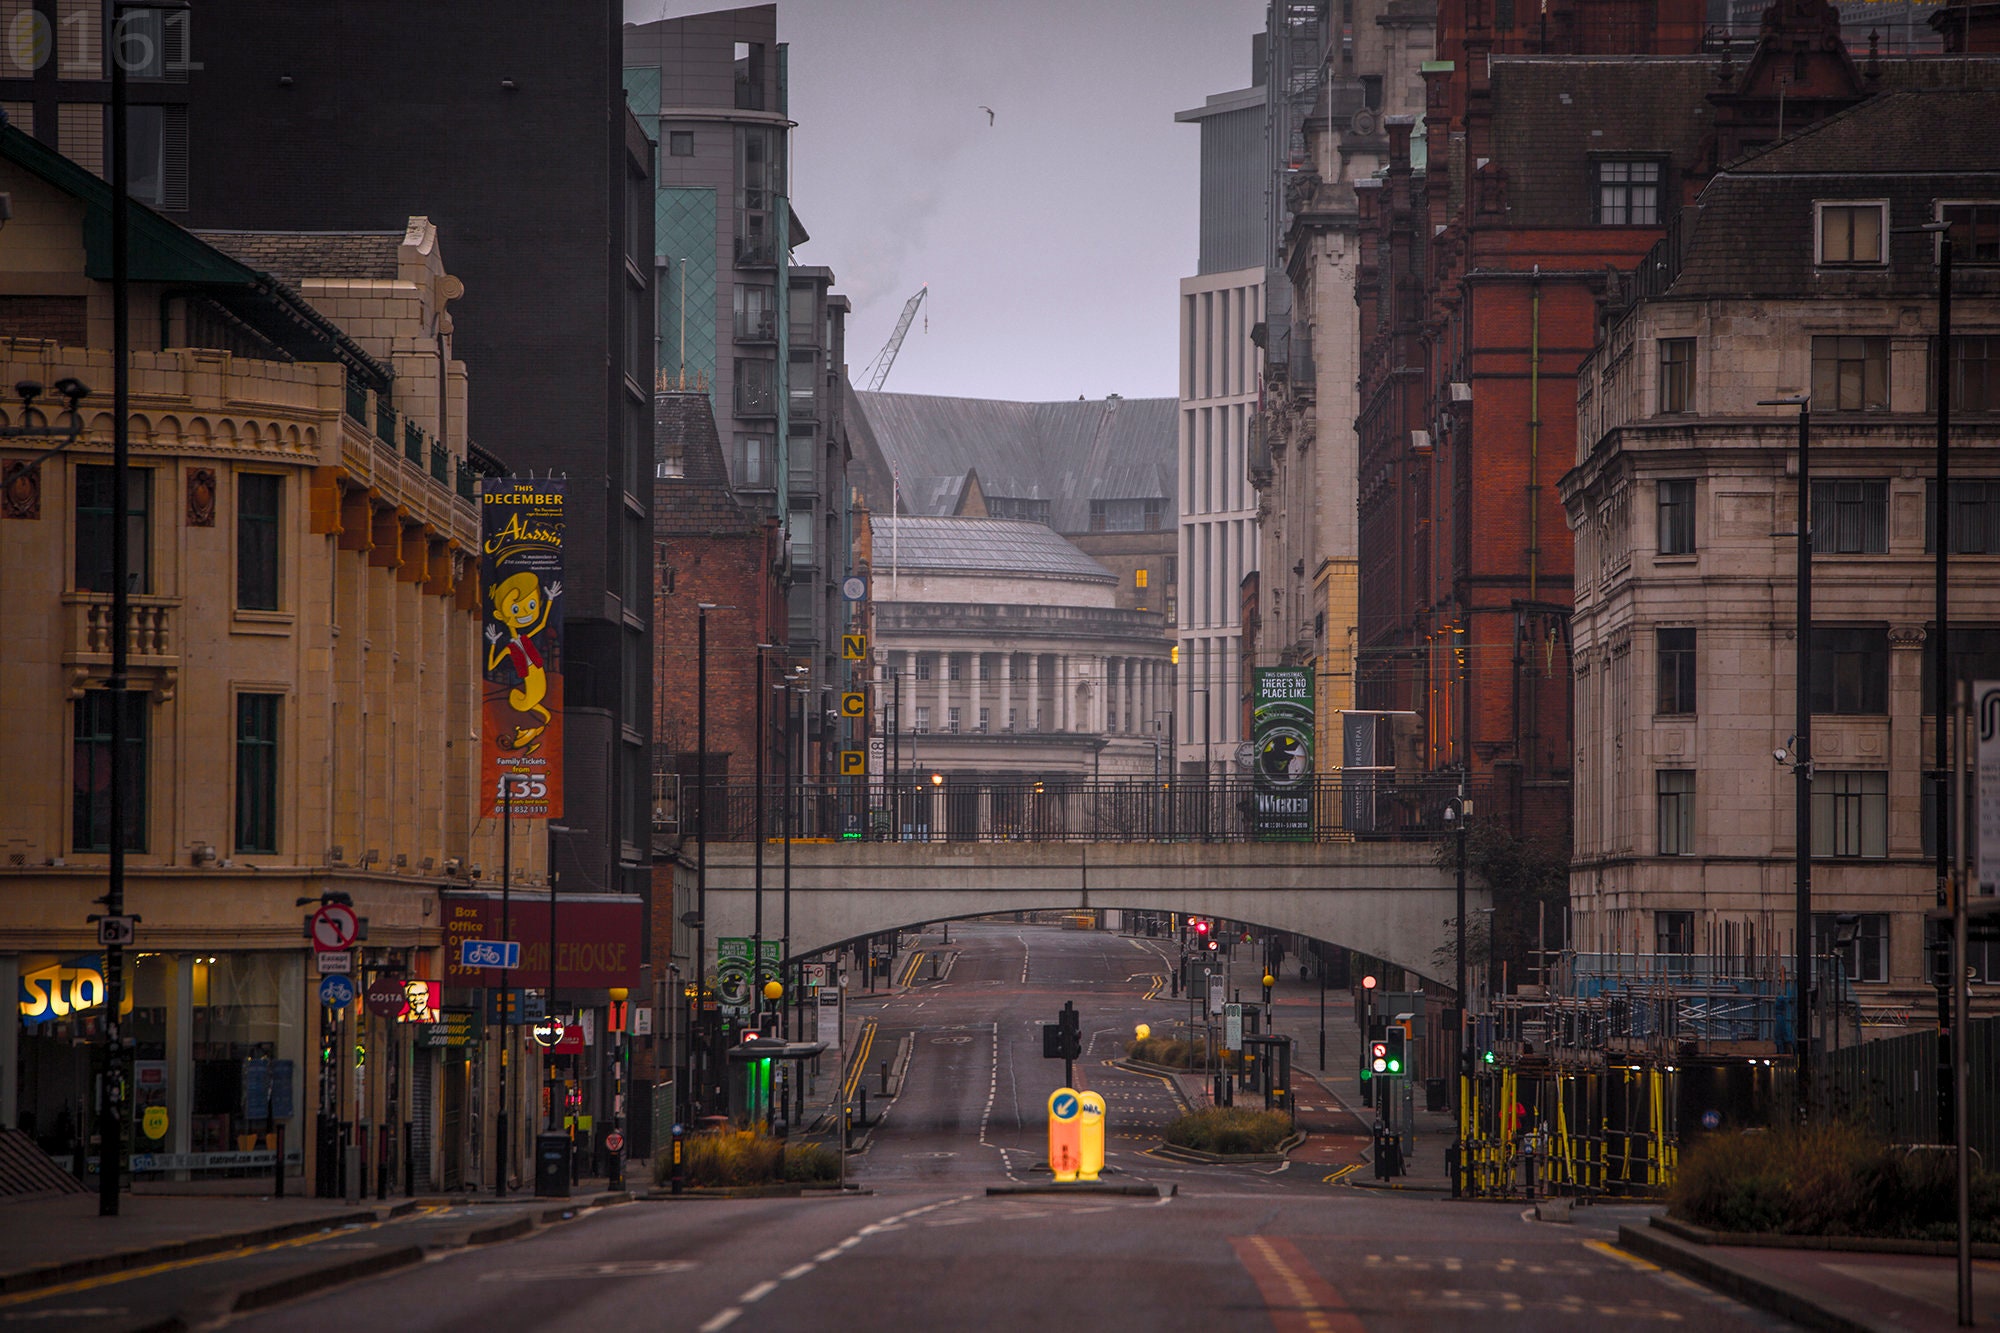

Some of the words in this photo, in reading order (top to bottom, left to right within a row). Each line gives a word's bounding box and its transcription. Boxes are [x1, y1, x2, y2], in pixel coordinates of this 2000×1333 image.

[484, 493, 563, 504] DECEMBER
[484, 512, 561, 554] Aladdin
[1261, 678, 1293, 688] THERE'S
[1295, 678, 1306, 688] NO
[1262, 688, 1287, 698] PLACE
[496, 757, 520, 766] Family
[455, 907, 478, 917] Box
[449, 921, 484, 931] Office
[493, 918, 517, 939] TE
[517, 942, 627, 971] DANEHOUSE
[322, 962, 346, 970] cycles
[19, 963, 104, 1016] sta
[370, 993, 403, 1003] COSTA
[428, 1025, 471, 1034] SUBWAY
[427, 1036, 471, 1045] SUBWAY
